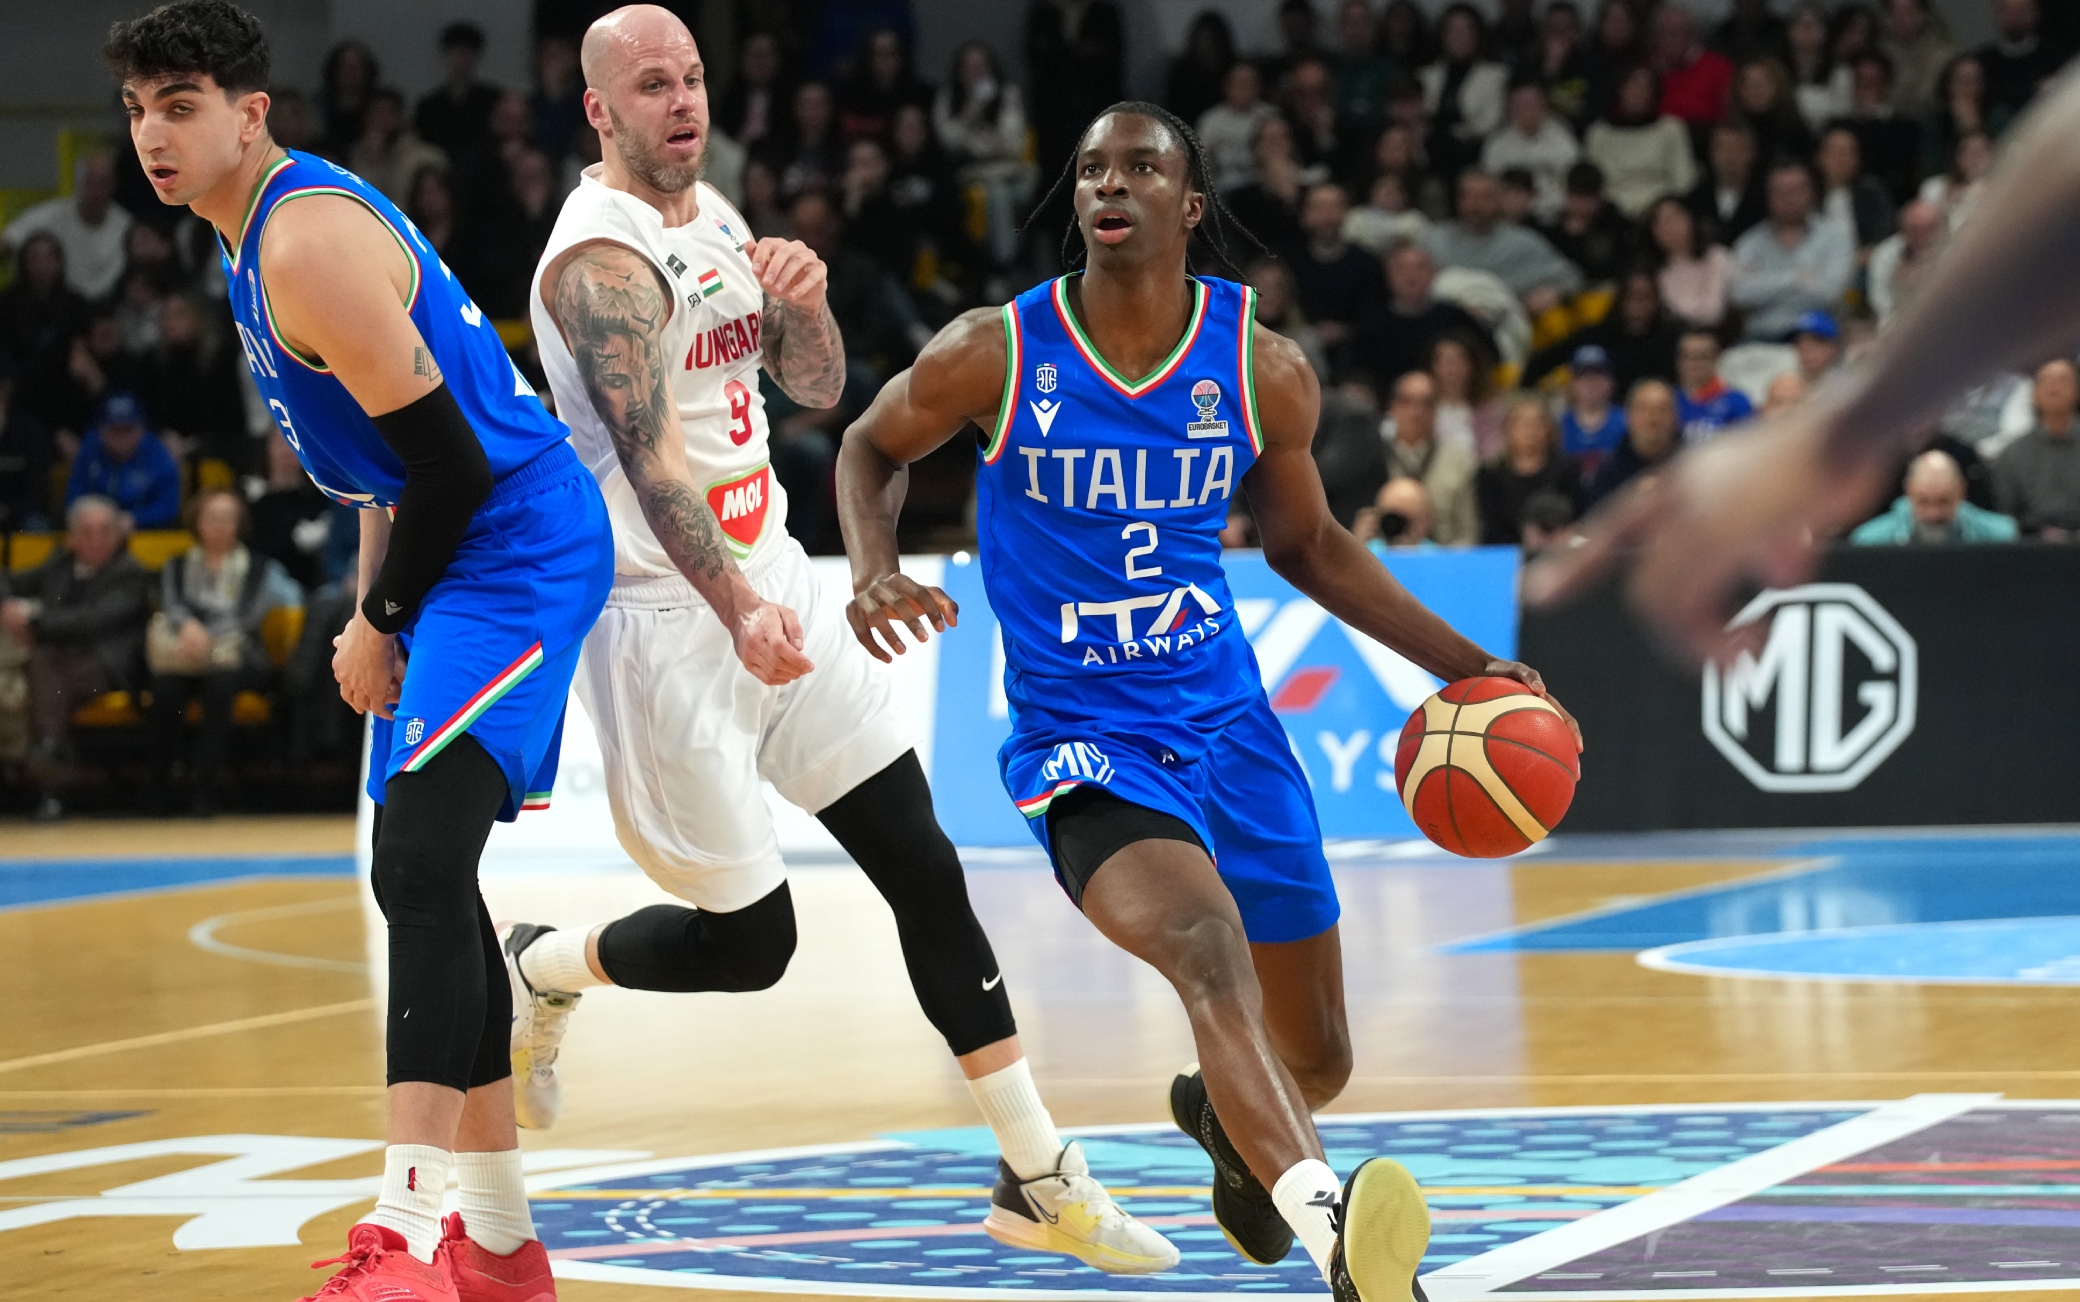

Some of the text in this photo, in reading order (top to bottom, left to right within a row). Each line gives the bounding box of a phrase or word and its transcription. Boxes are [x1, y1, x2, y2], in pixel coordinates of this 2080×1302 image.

[684, 309, 763, 371] UNGAR
[723, 379, 753, 447] 9
[1188, 421, 1227, 431] EUROBASKET
[721, 477, 763, 521] MOL
[1018, 445, 1234, 510] ITALIA
[1121, 521, 1162, 581] 2
[1060, 582, 1222, 644] ITA
[1082, 617, 1220, 666] AIRWAYS
[1721, 601, 1898, 773] MG
